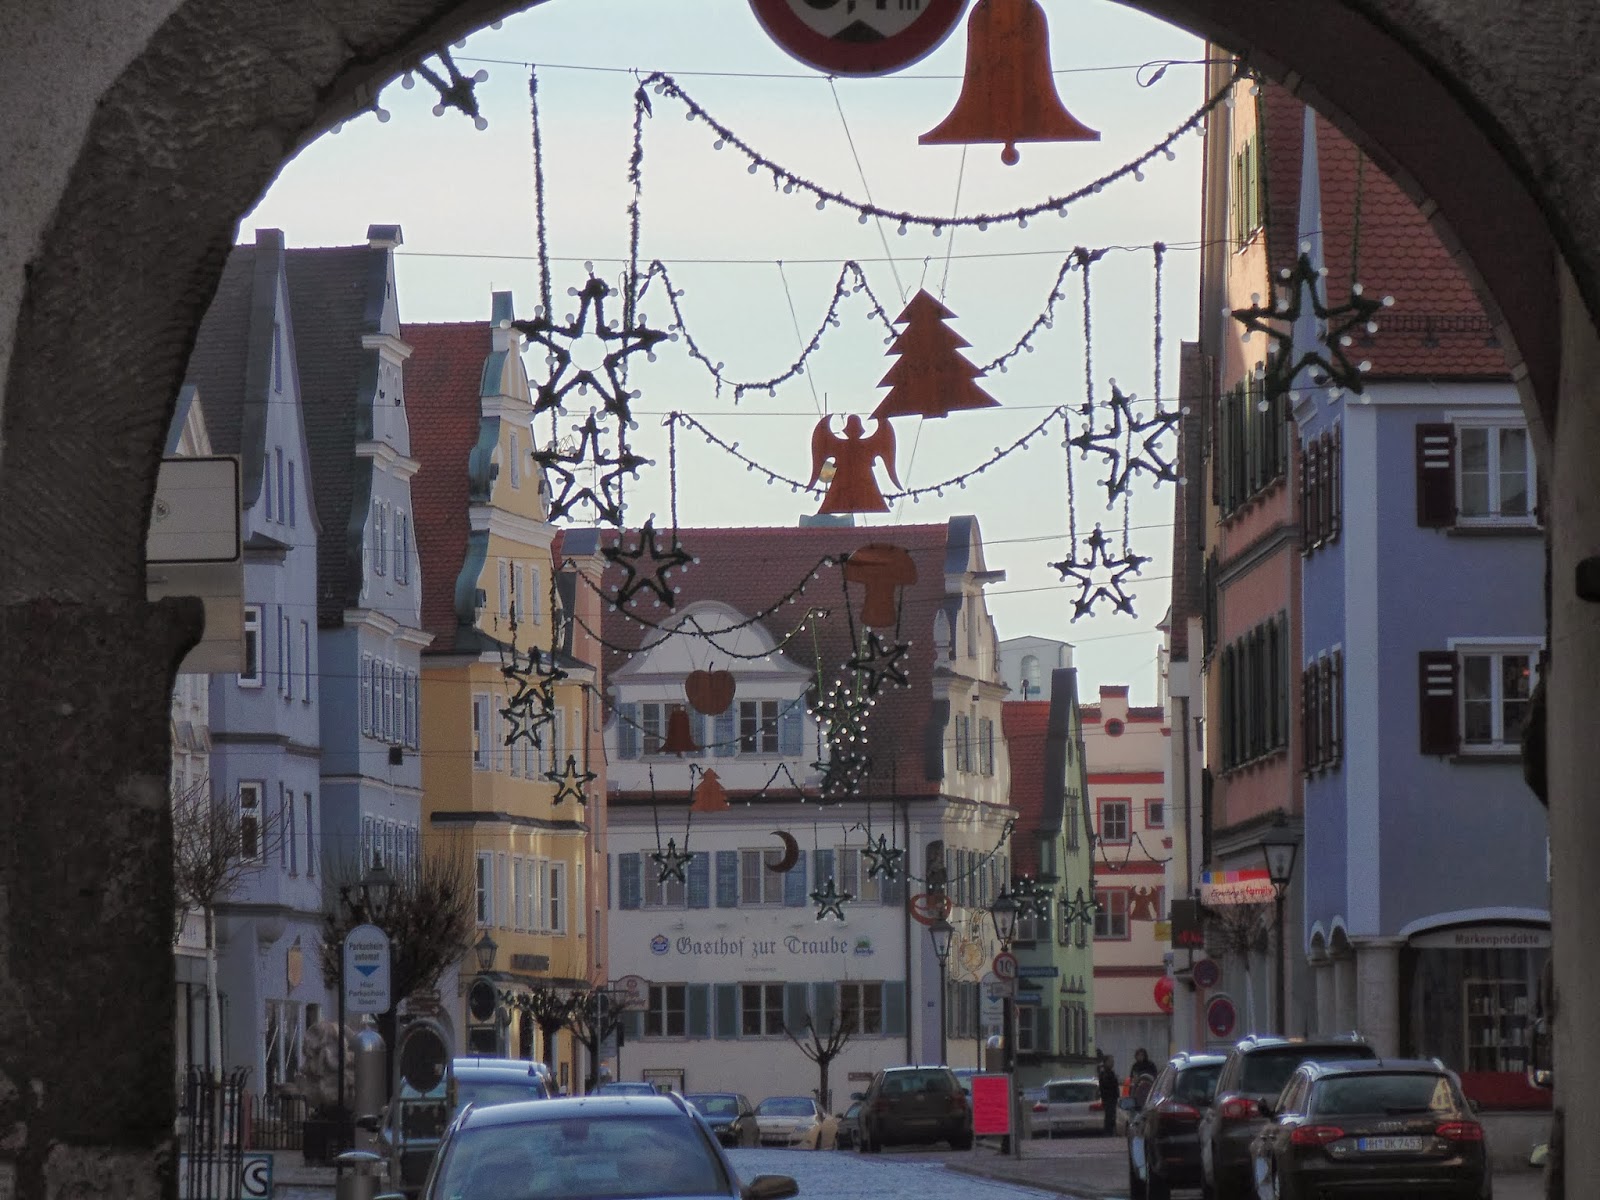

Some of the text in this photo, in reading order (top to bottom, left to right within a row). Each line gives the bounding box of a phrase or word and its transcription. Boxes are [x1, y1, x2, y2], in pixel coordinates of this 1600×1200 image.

[676, 935, 848, 958] Gasthof zur Traube
[1455, 933, 1539, 945] Markenprodukte
